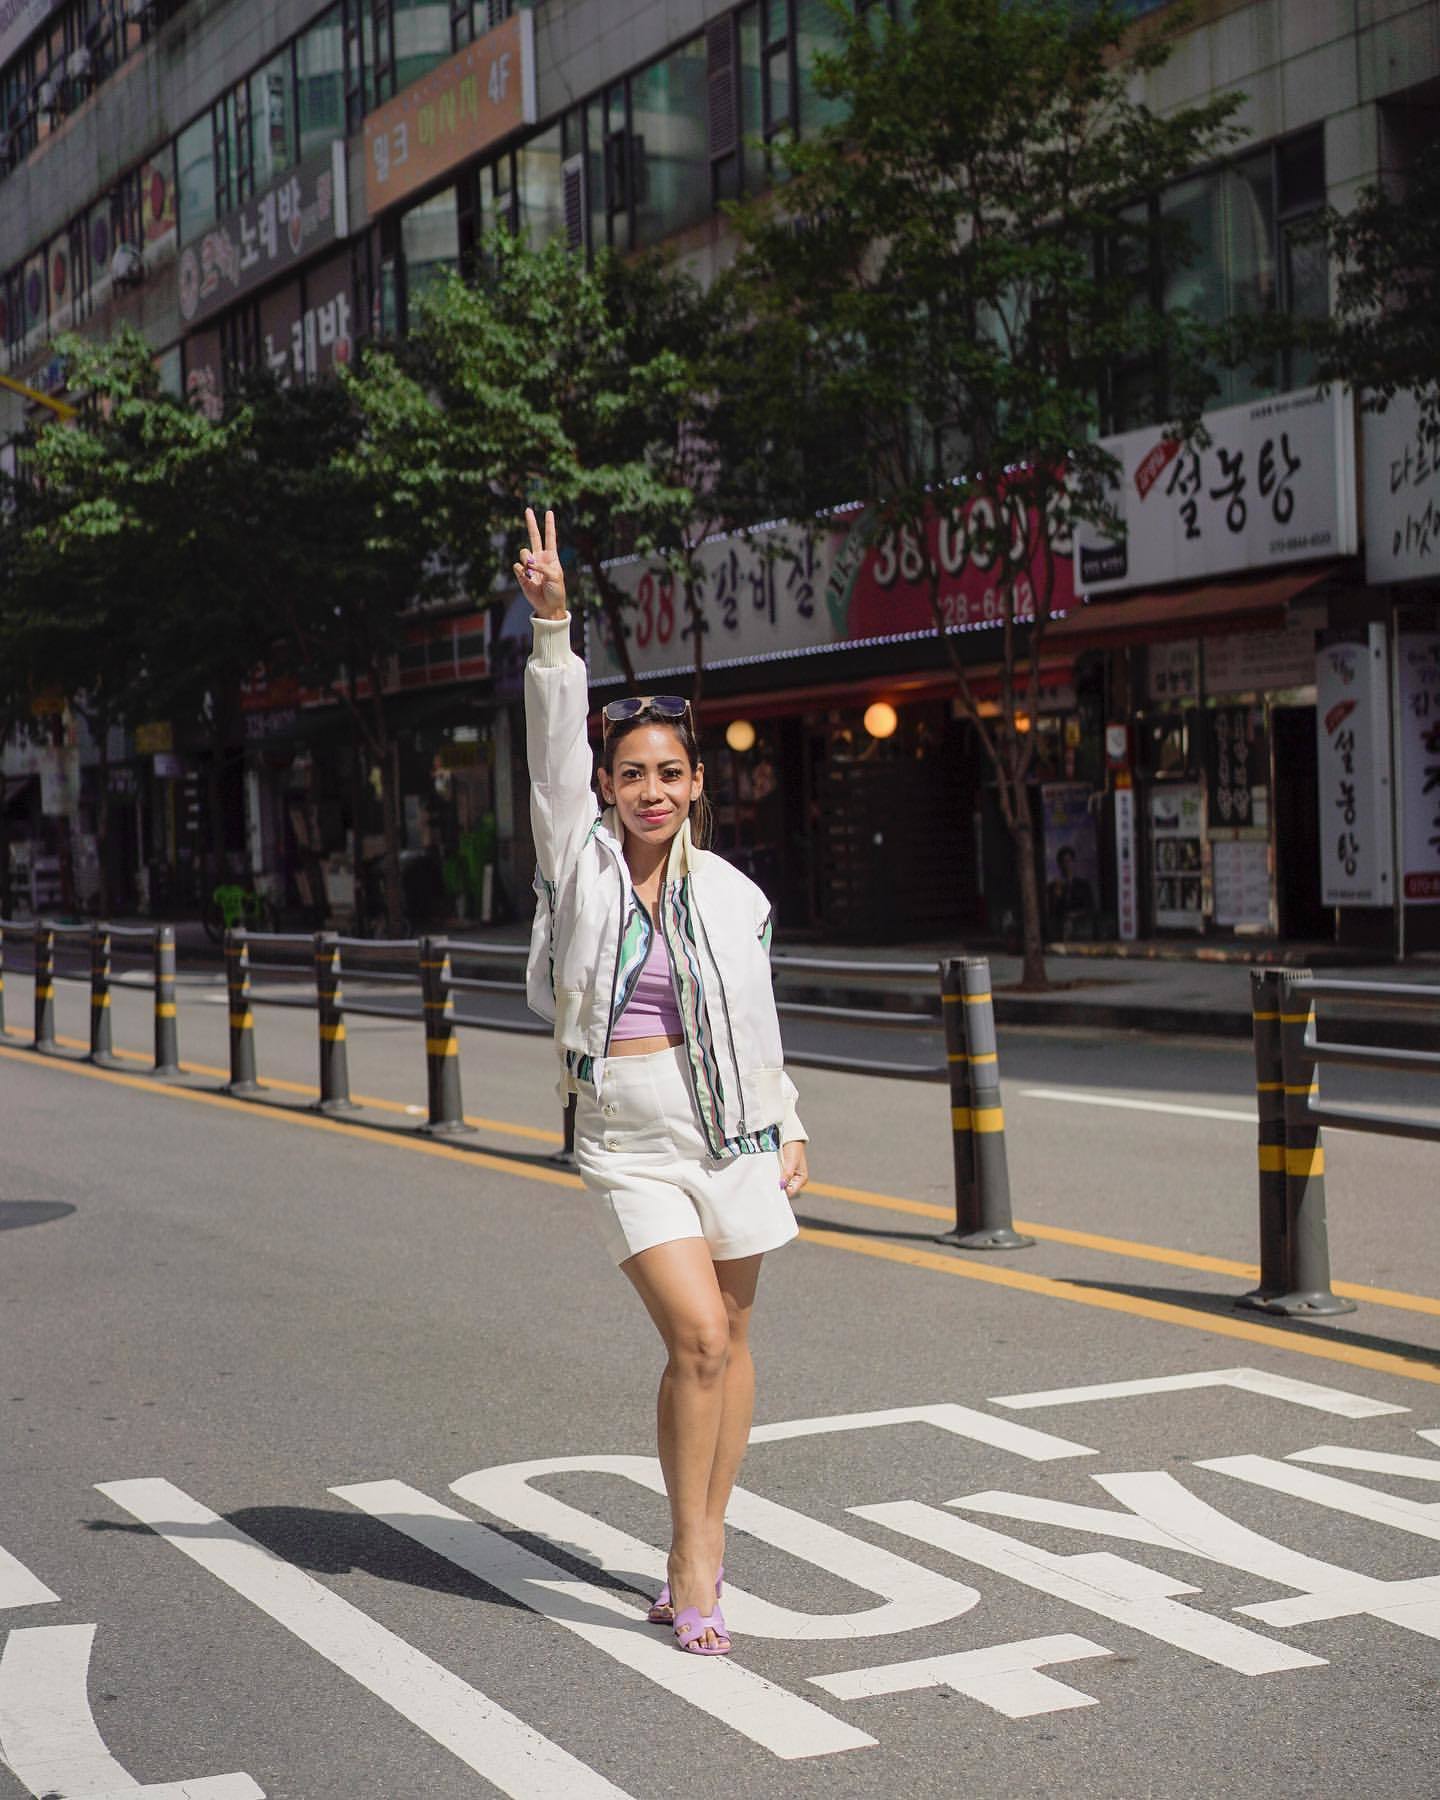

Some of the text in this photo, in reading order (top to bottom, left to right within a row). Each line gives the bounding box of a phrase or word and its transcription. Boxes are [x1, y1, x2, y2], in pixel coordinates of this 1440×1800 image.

[488, 51, 512, 104] 4F
[239, 175, 301, 271] 노래방
[1166, 432, 1302, 541] 설농탕
[1333, 729, 1360, 878] 설농탕
